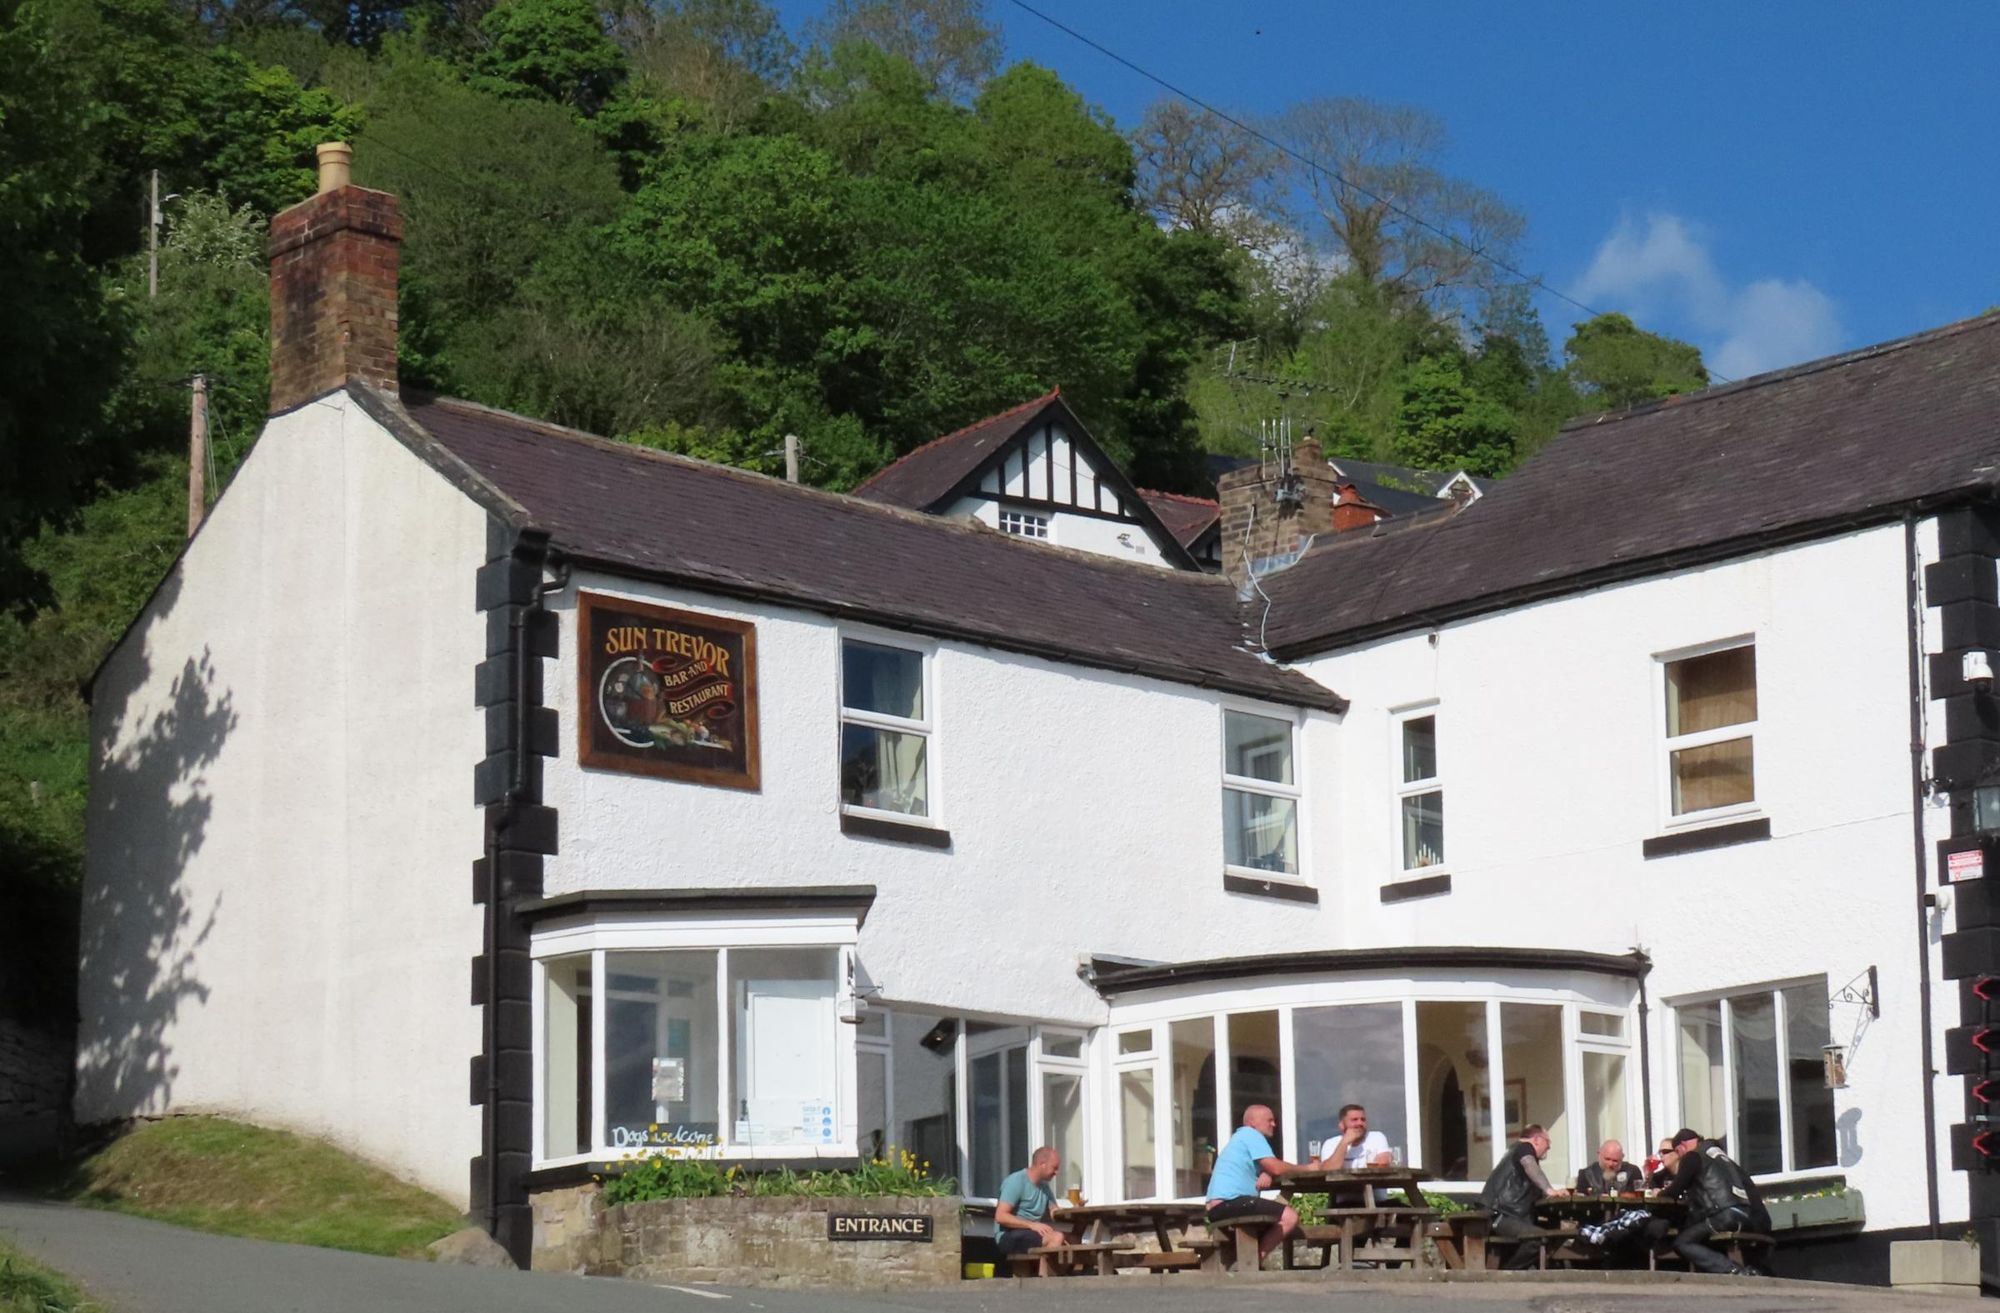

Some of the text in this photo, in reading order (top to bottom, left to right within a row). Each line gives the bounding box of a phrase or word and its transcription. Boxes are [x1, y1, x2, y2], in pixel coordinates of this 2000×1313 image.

[606, 627, 730, 677] SUN TREVOR
[670, 685, 729, 714] RESTAURANT
[612, 1127, 649, 1148] Dogs
[835, 1218, 925, 1233] ENTRANCE
